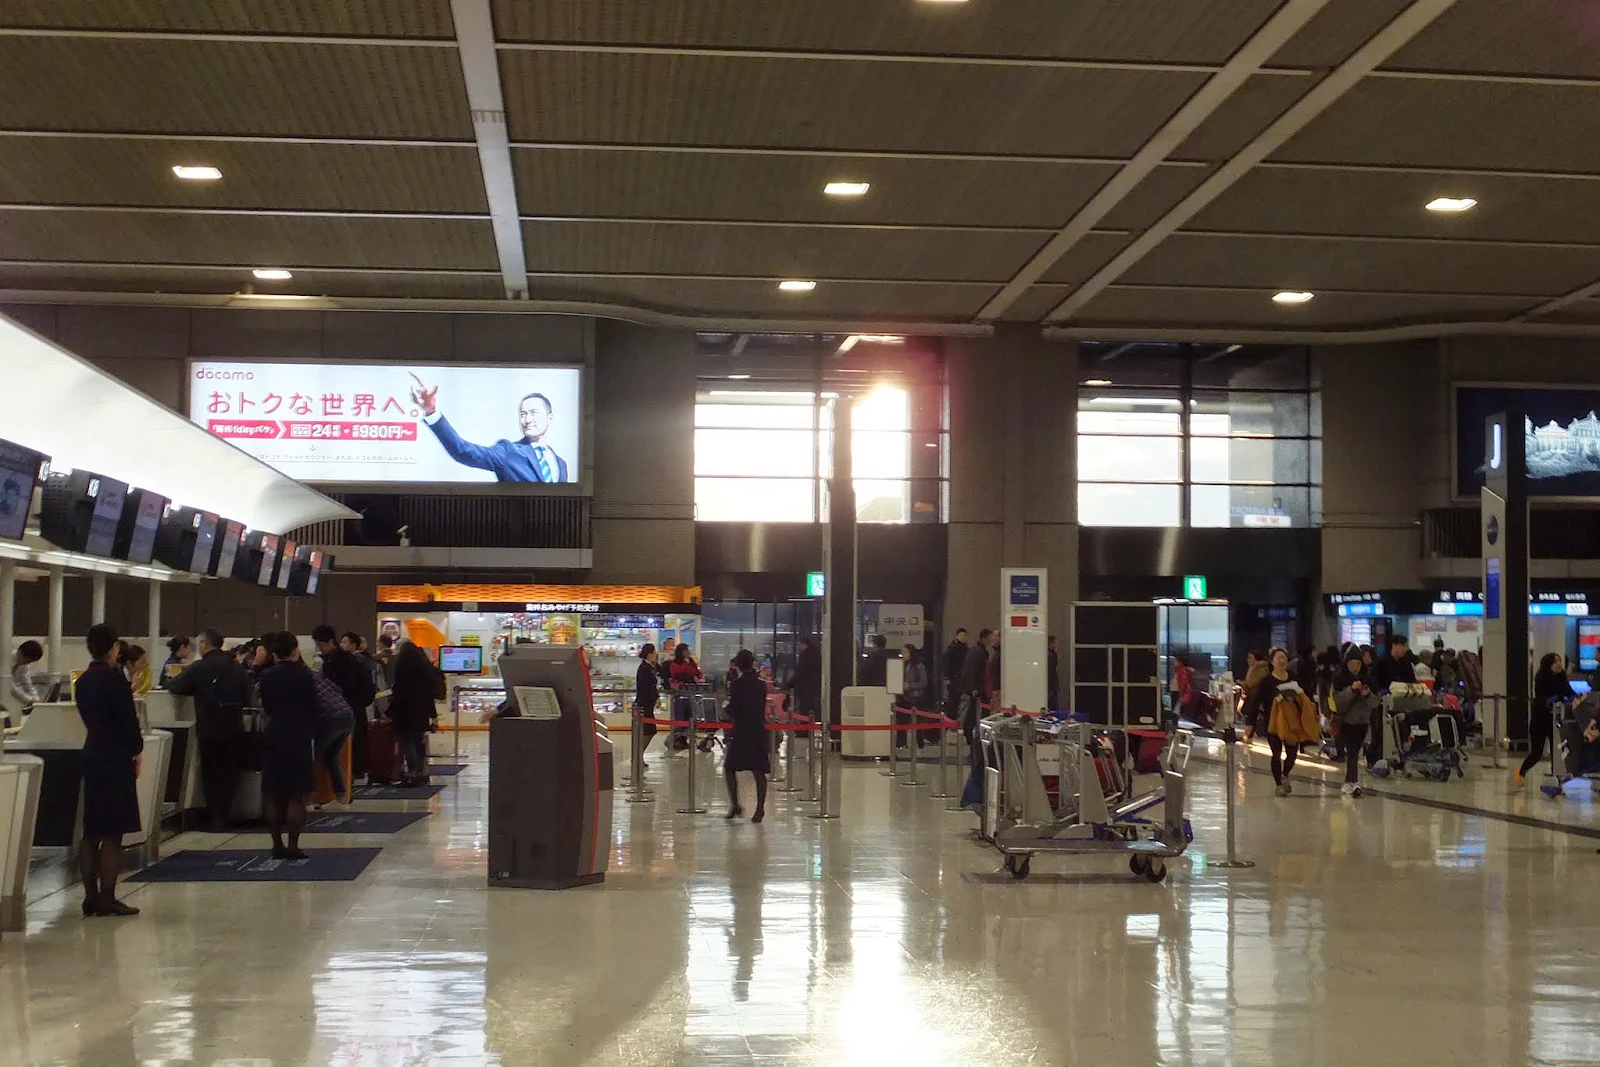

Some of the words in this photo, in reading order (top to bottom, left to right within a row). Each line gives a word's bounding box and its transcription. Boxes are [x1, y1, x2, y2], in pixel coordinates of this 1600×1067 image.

[196, 367, 255, 380] docomo
[207, 390, 420, 418] おトクな世界へ。
[1490, 423, 1501, 469] J
